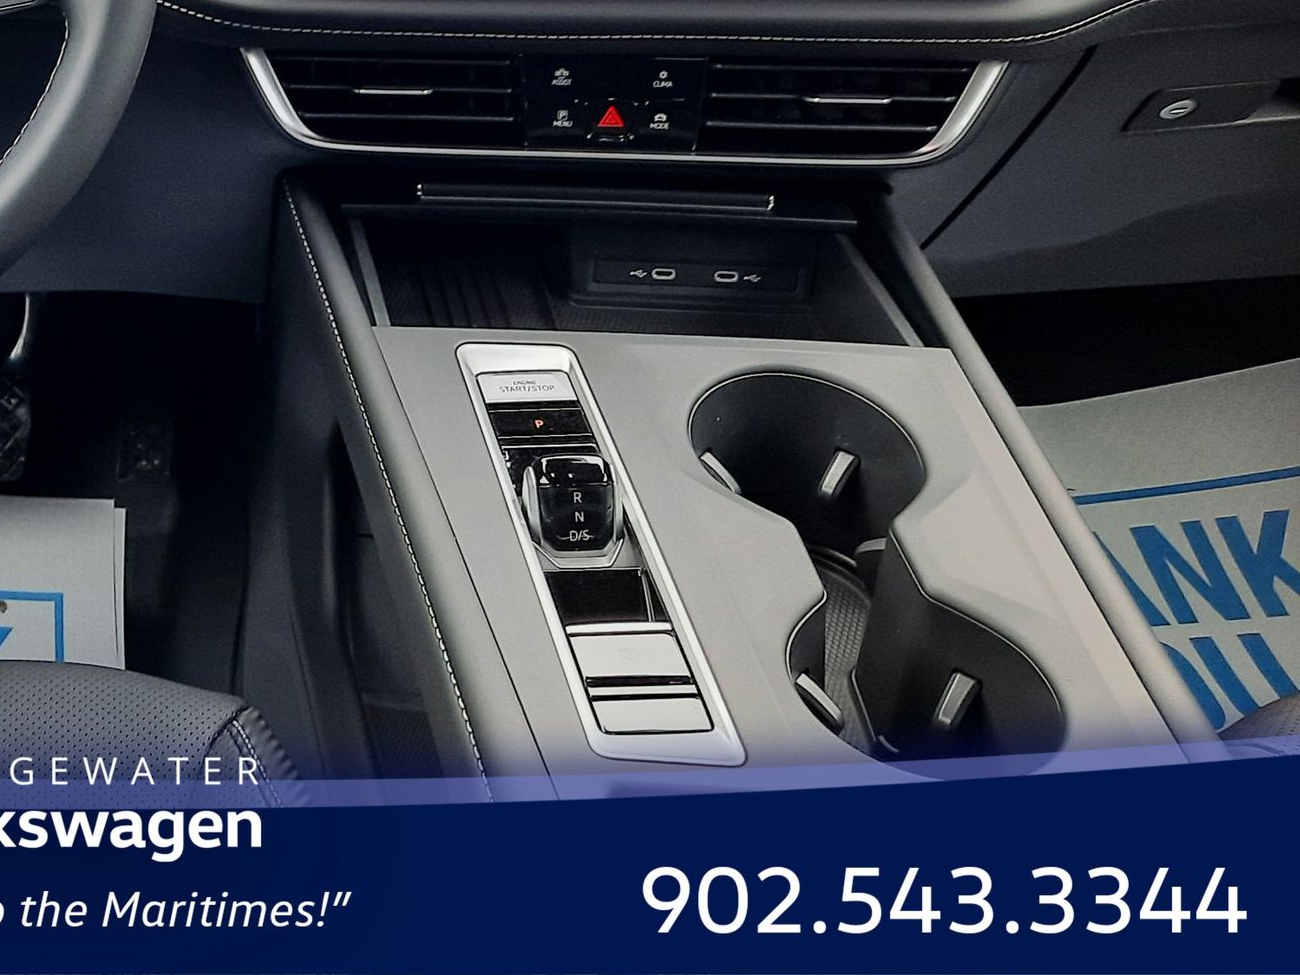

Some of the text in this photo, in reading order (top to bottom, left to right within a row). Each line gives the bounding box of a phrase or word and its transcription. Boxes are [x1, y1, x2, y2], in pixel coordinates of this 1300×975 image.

[499, 385, 555, 393] START/STOP
[534, 419, 544, 429] P
[573, 491, 583, 504] R
[575, 511, 584, 523] N
[570, 529, 590, 542] D/S
